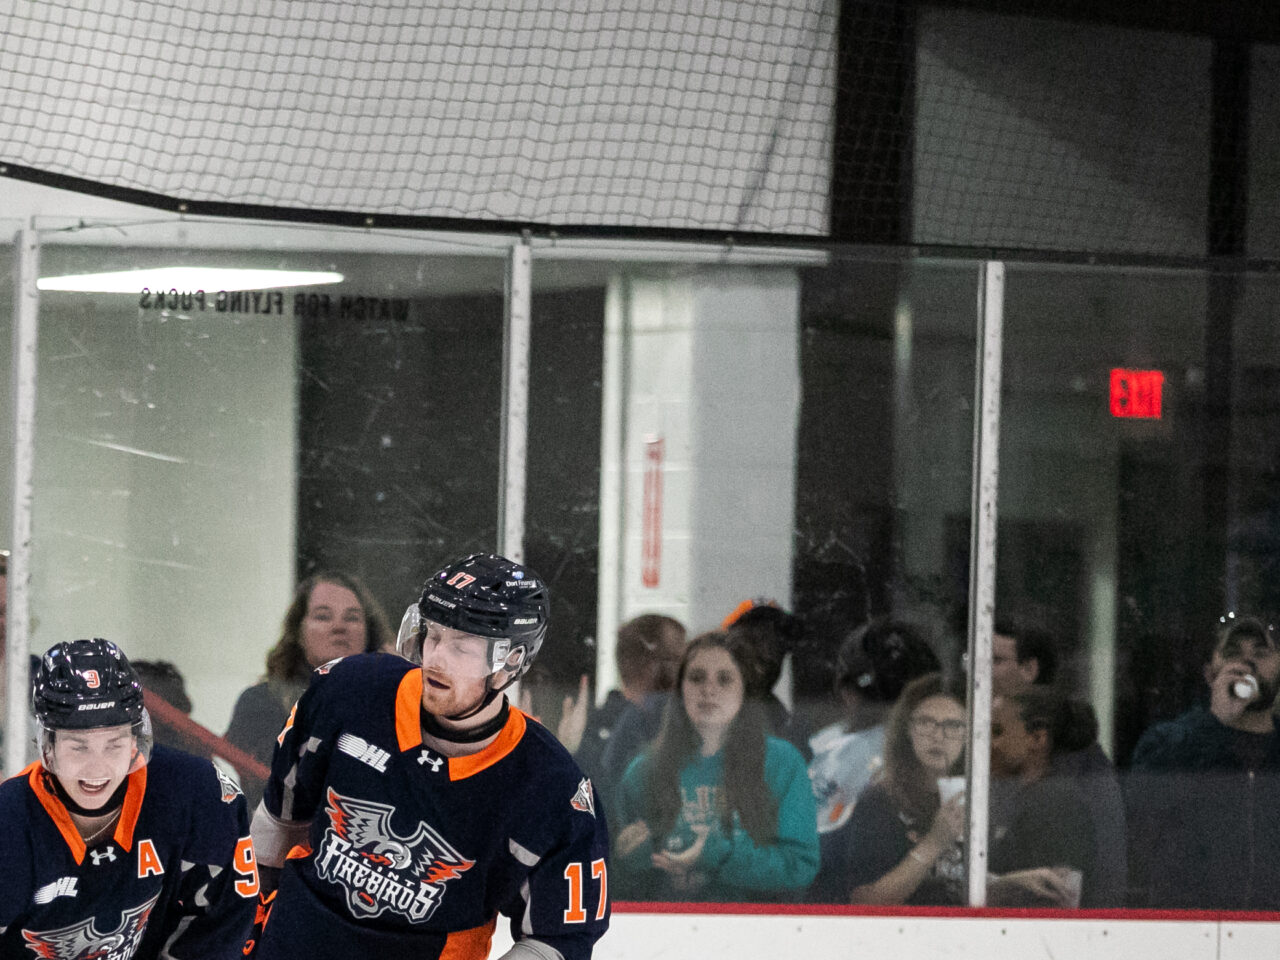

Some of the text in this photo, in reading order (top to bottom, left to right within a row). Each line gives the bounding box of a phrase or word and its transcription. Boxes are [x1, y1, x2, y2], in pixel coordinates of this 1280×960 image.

[447, 571, 477, 590] 17
[82, 669, 100, 688] 9
[137, 838, 165, 879] A
[233, 834, 261, 898] 9
[349, 850, 415, 887] FLINT
[563, 857, 608, 924] 17
